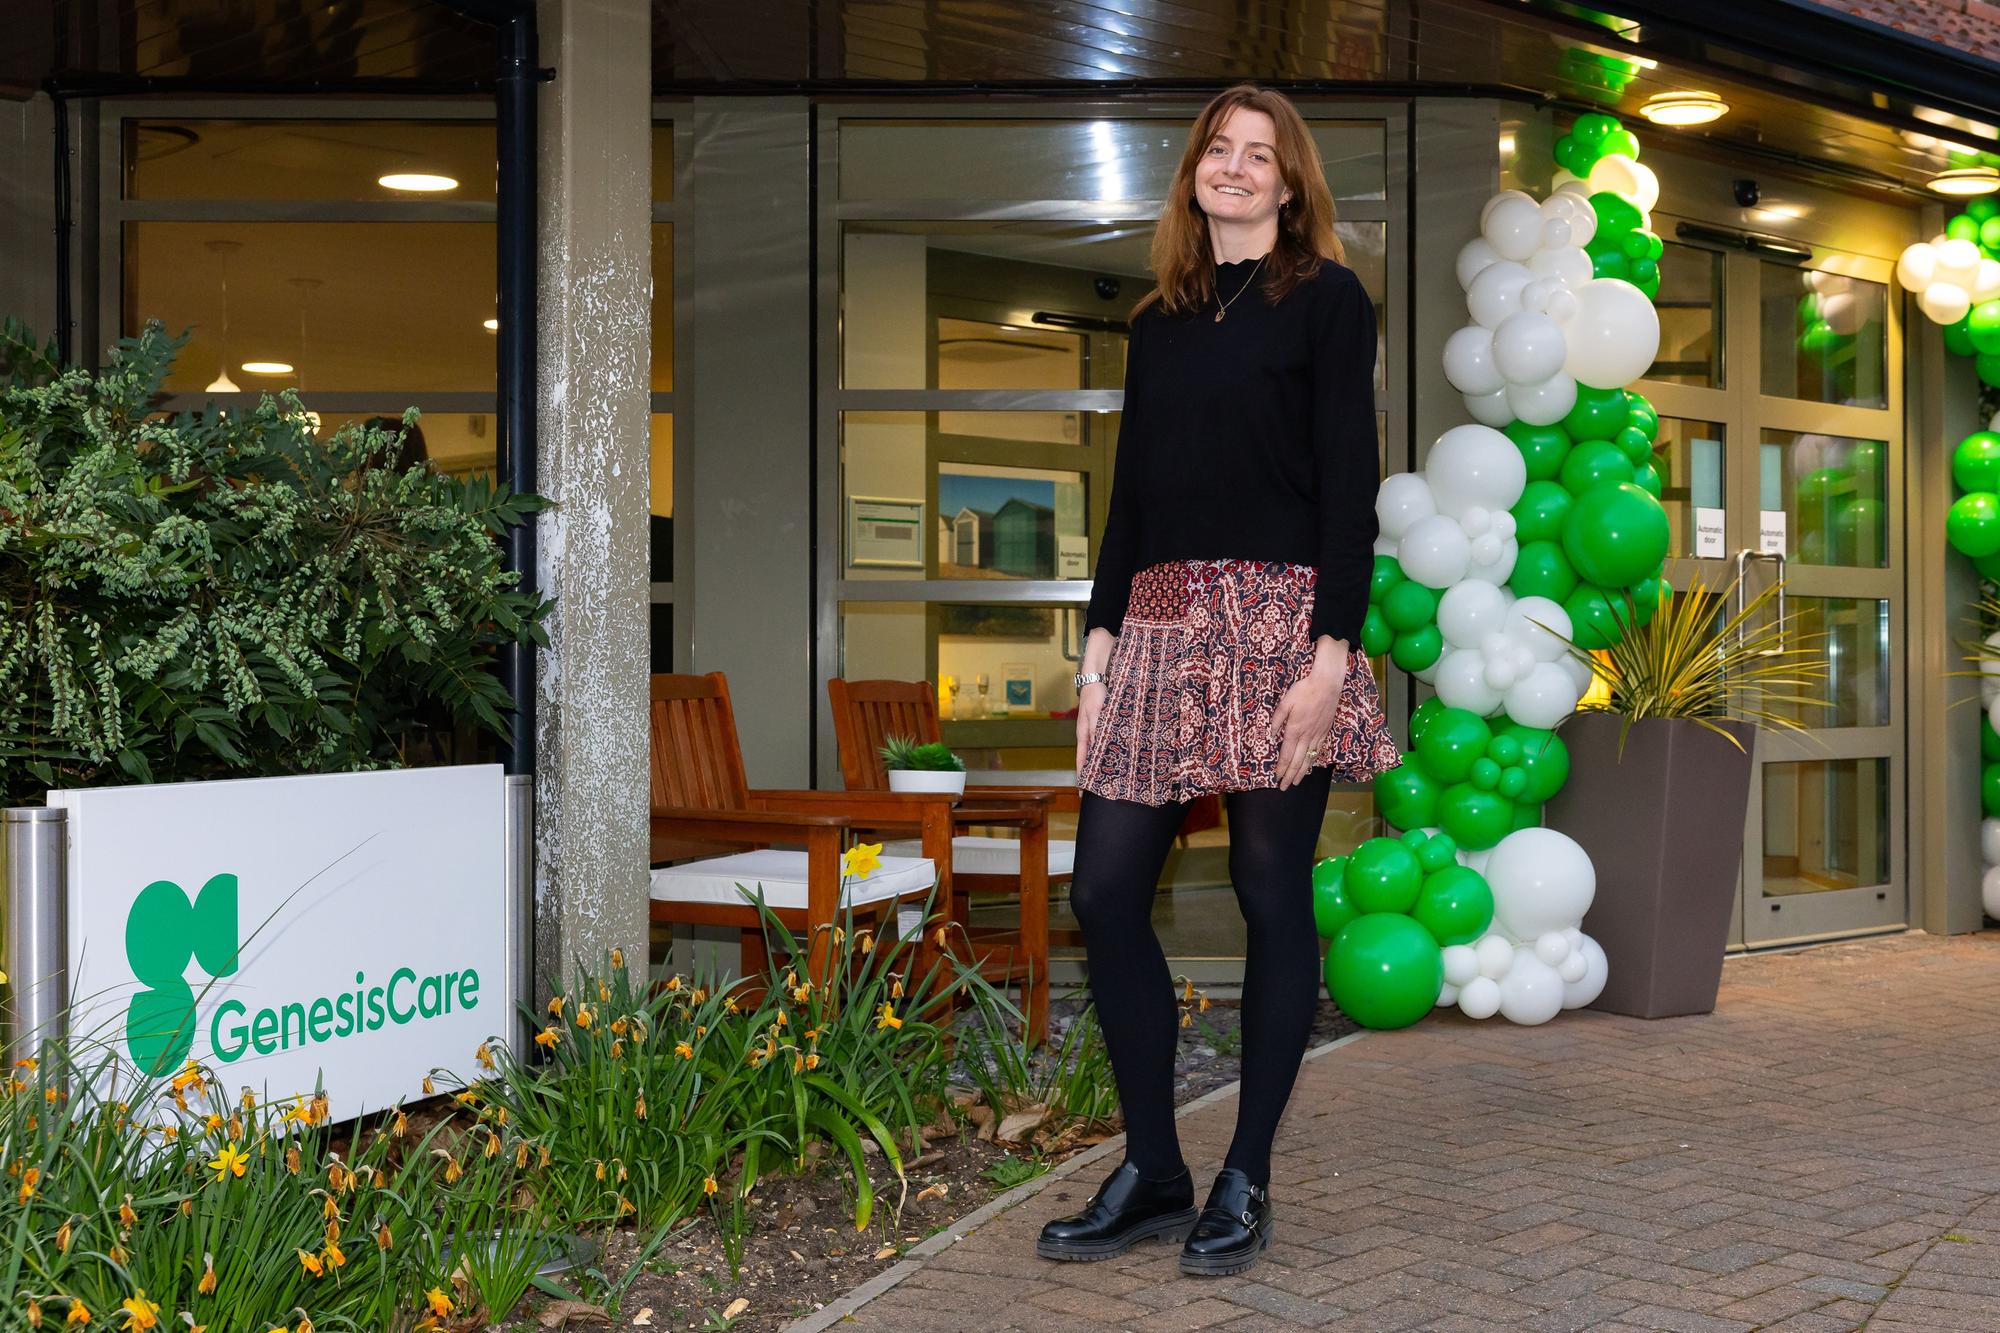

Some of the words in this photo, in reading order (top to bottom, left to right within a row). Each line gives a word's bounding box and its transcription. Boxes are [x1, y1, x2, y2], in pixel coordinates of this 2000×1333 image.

[1698, 525, 1723, 534] Automatic
[1760, 529, 1785, 538] Automatic
[210, 966, 480, 1063] GenesisCare
